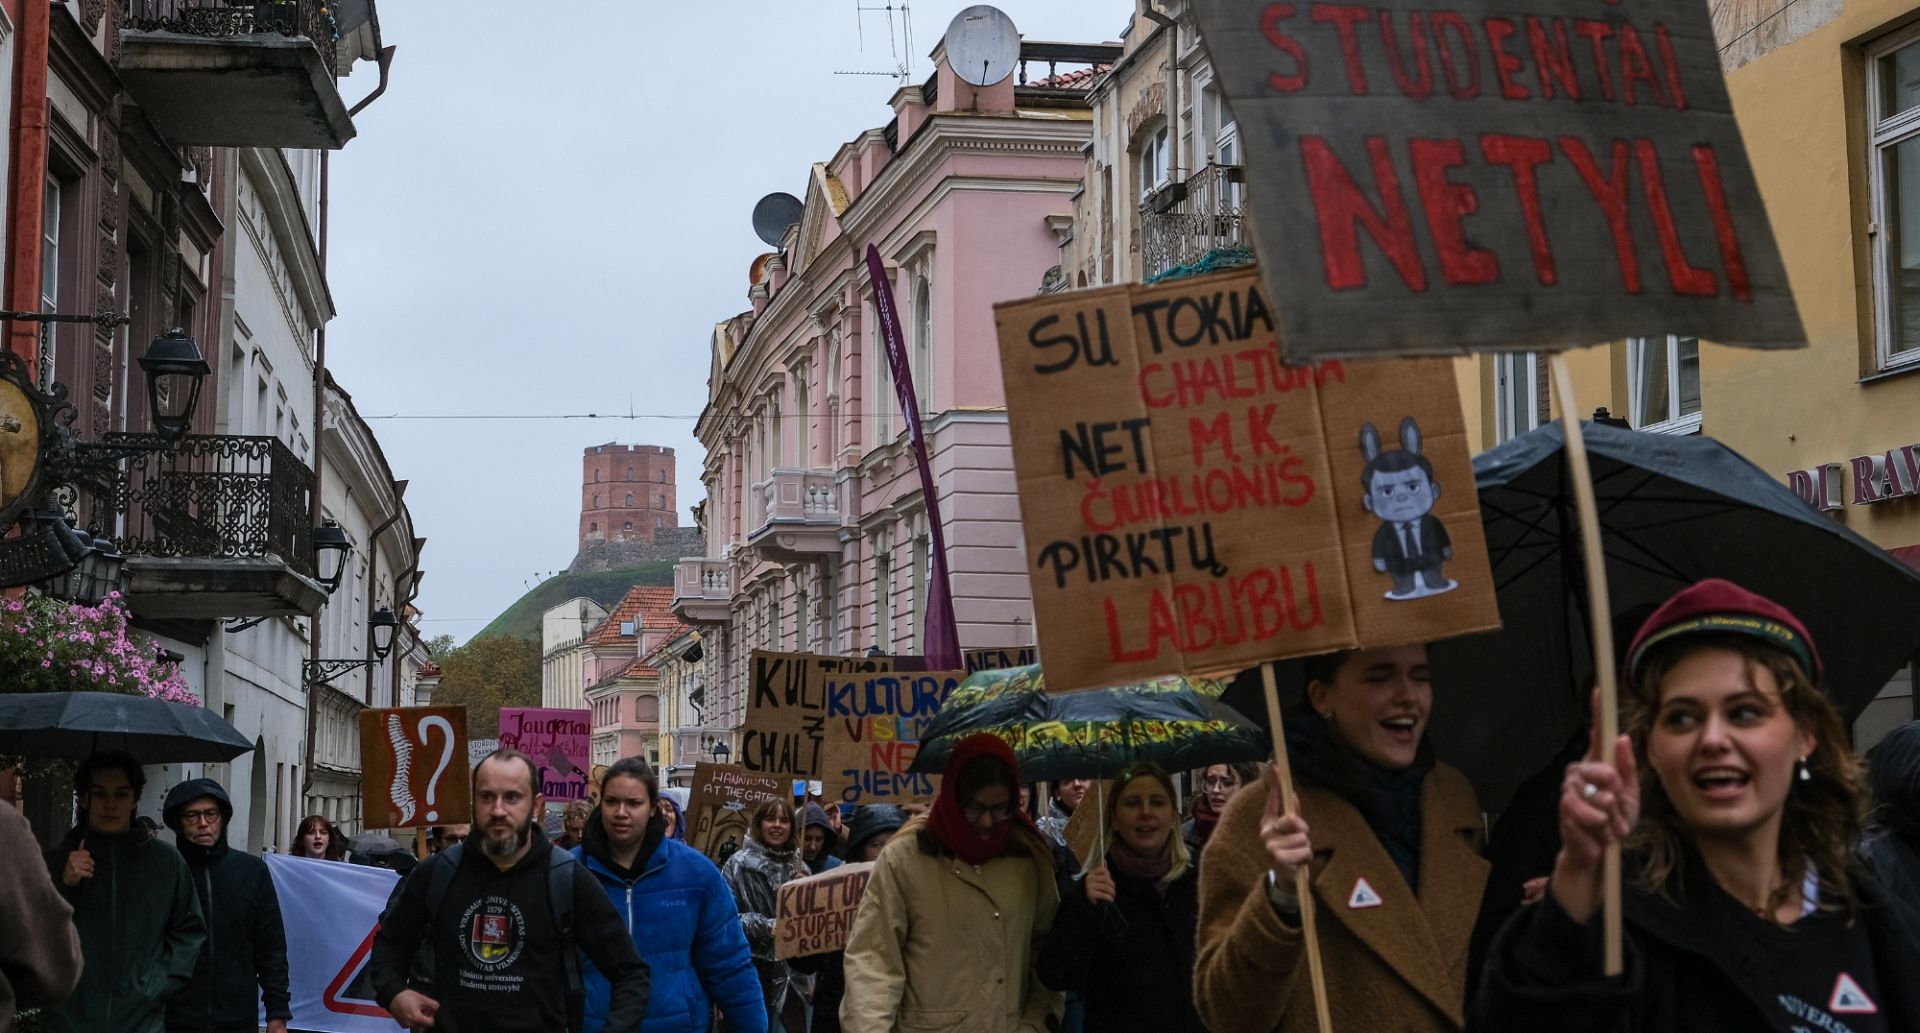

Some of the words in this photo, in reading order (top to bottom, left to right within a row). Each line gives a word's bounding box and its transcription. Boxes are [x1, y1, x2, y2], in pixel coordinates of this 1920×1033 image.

[1259, 2, 1689, 112] STUDENTAI
[1299, 134, 1754, 303] NETYLI
[1028, 309, 1119, 375] SU
[1132, 286, 1275, 354] TOKIA
[1060, 418, 1151, 480] NET
[1081, 457, 1317, 534] ČIURLIONIS
[1037, 522, 1229, 590] PIRKTŲ
[1103, 560, 1326, 664] LABUBU
[755, 657, 889, 710] KULT
[703, 784, 721, 796] AT
[725, 786, 745, 799] THE
[842, 769, 934, 802] JIEMS
